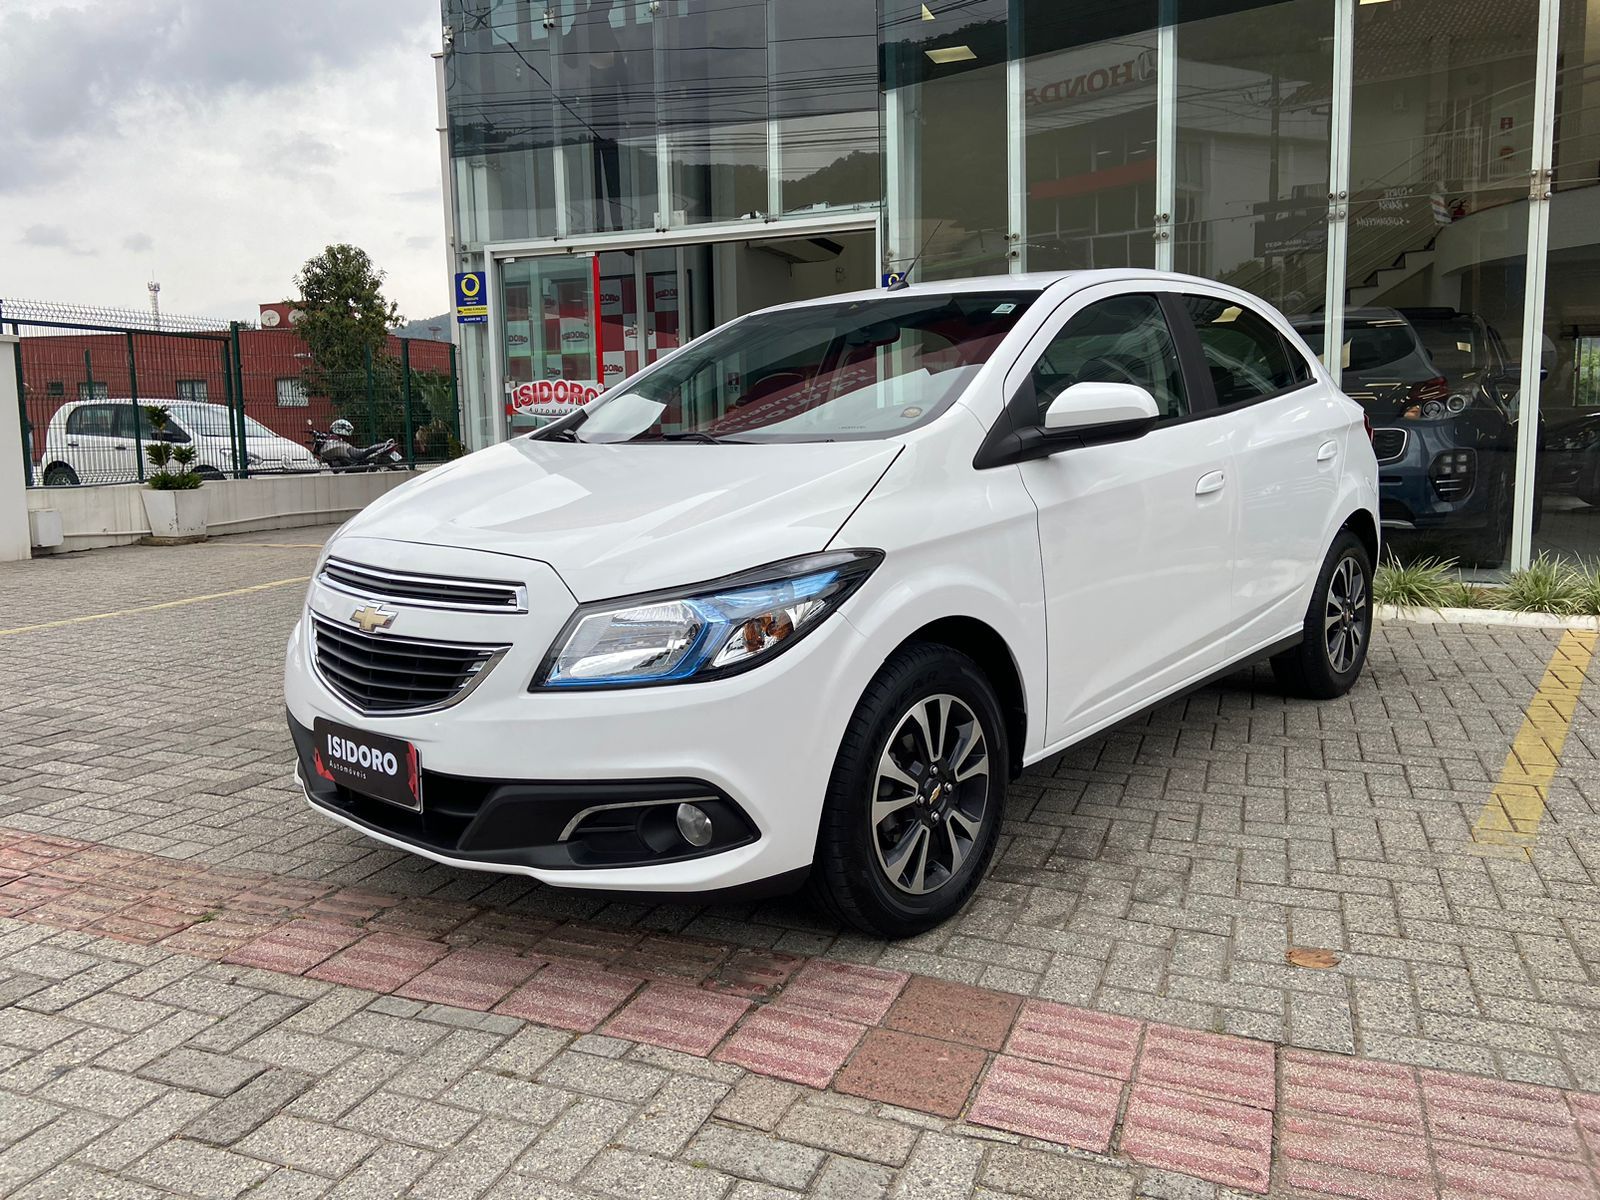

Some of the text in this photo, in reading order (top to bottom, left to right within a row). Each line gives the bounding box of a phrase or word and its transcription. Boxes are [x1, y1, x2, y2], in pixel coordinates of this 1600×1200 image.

[512, 380, 600, 408] ISIDORO
[529, 406, 578, 414] AUTOMÓVE
[327, 734, 398, 776] ISIDORO
[329, 760, 367, 780] Automóveis
